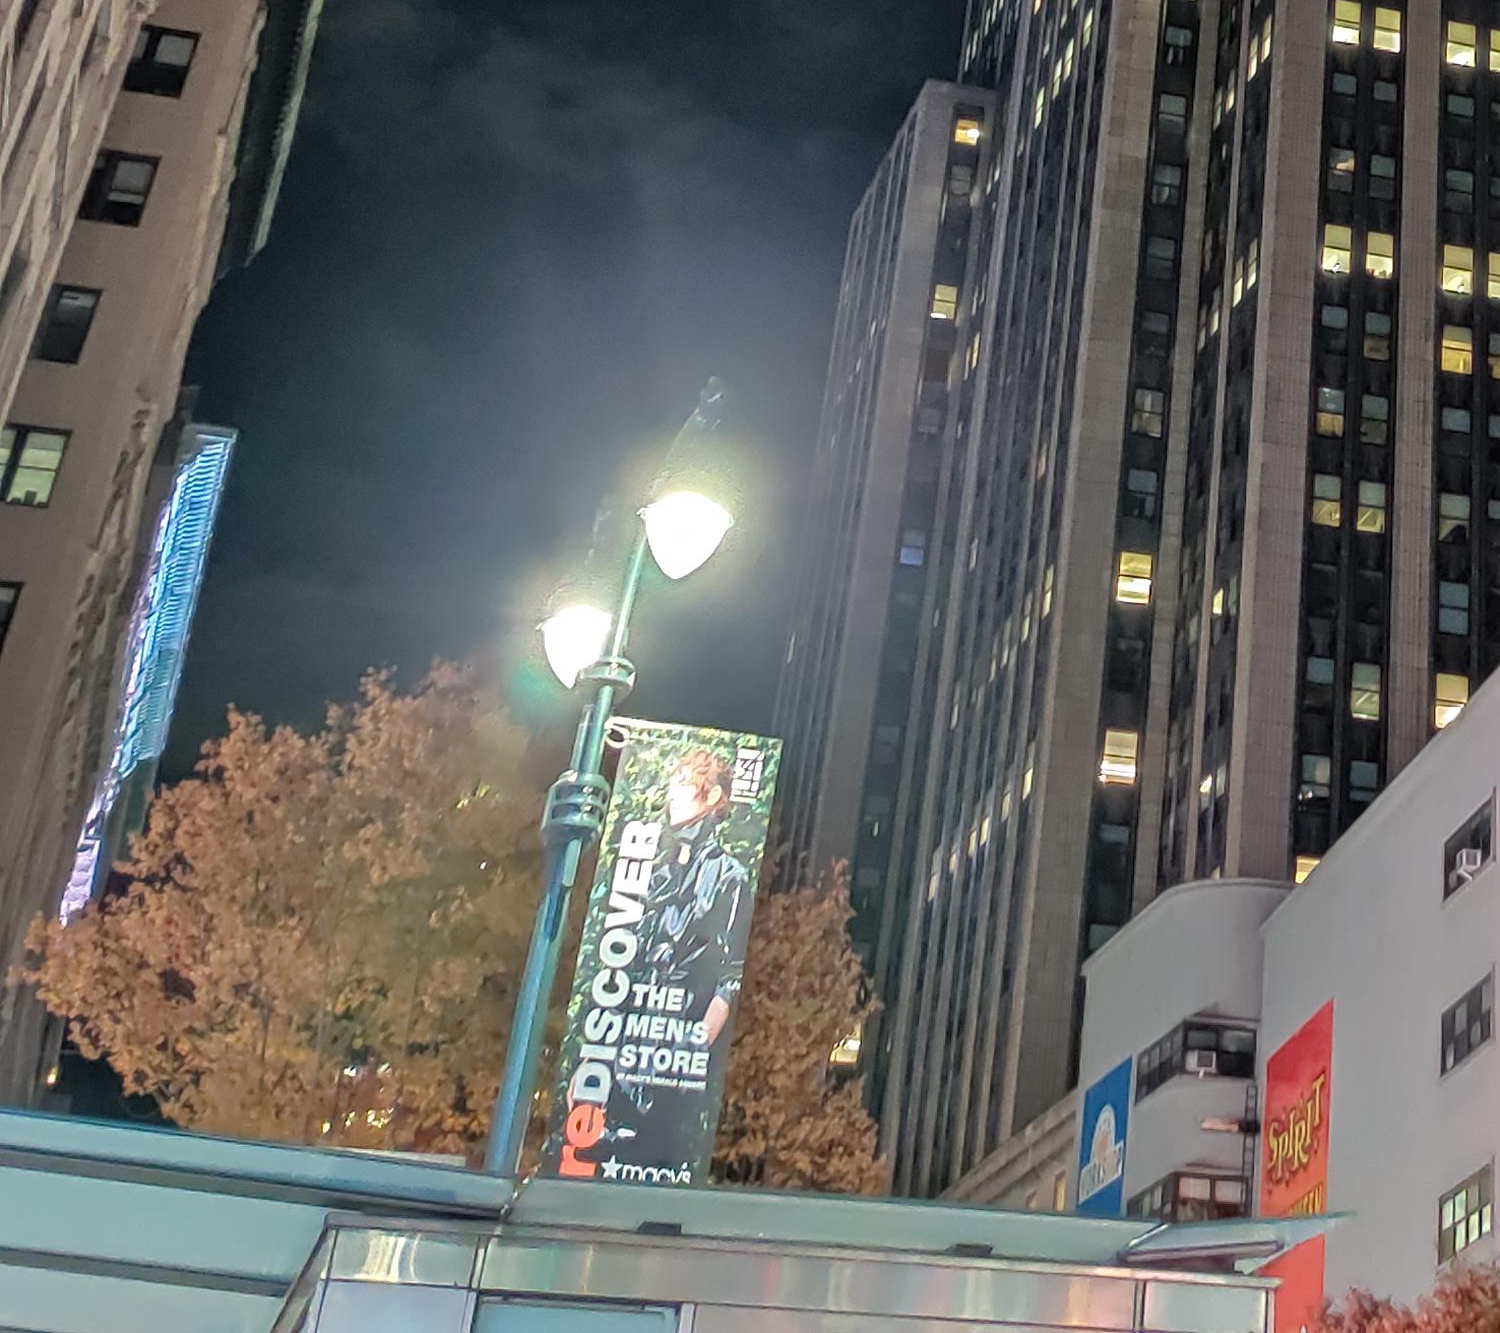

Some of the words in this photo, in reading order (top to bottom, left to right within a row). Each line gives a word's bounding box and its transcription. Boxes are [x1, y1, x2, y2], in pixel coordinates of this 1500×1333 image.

[632, 982, 686, 1012] THE
[624, 1012, 709, 1046] MEN'S
[618, 1043, 710, 1076] STORE
